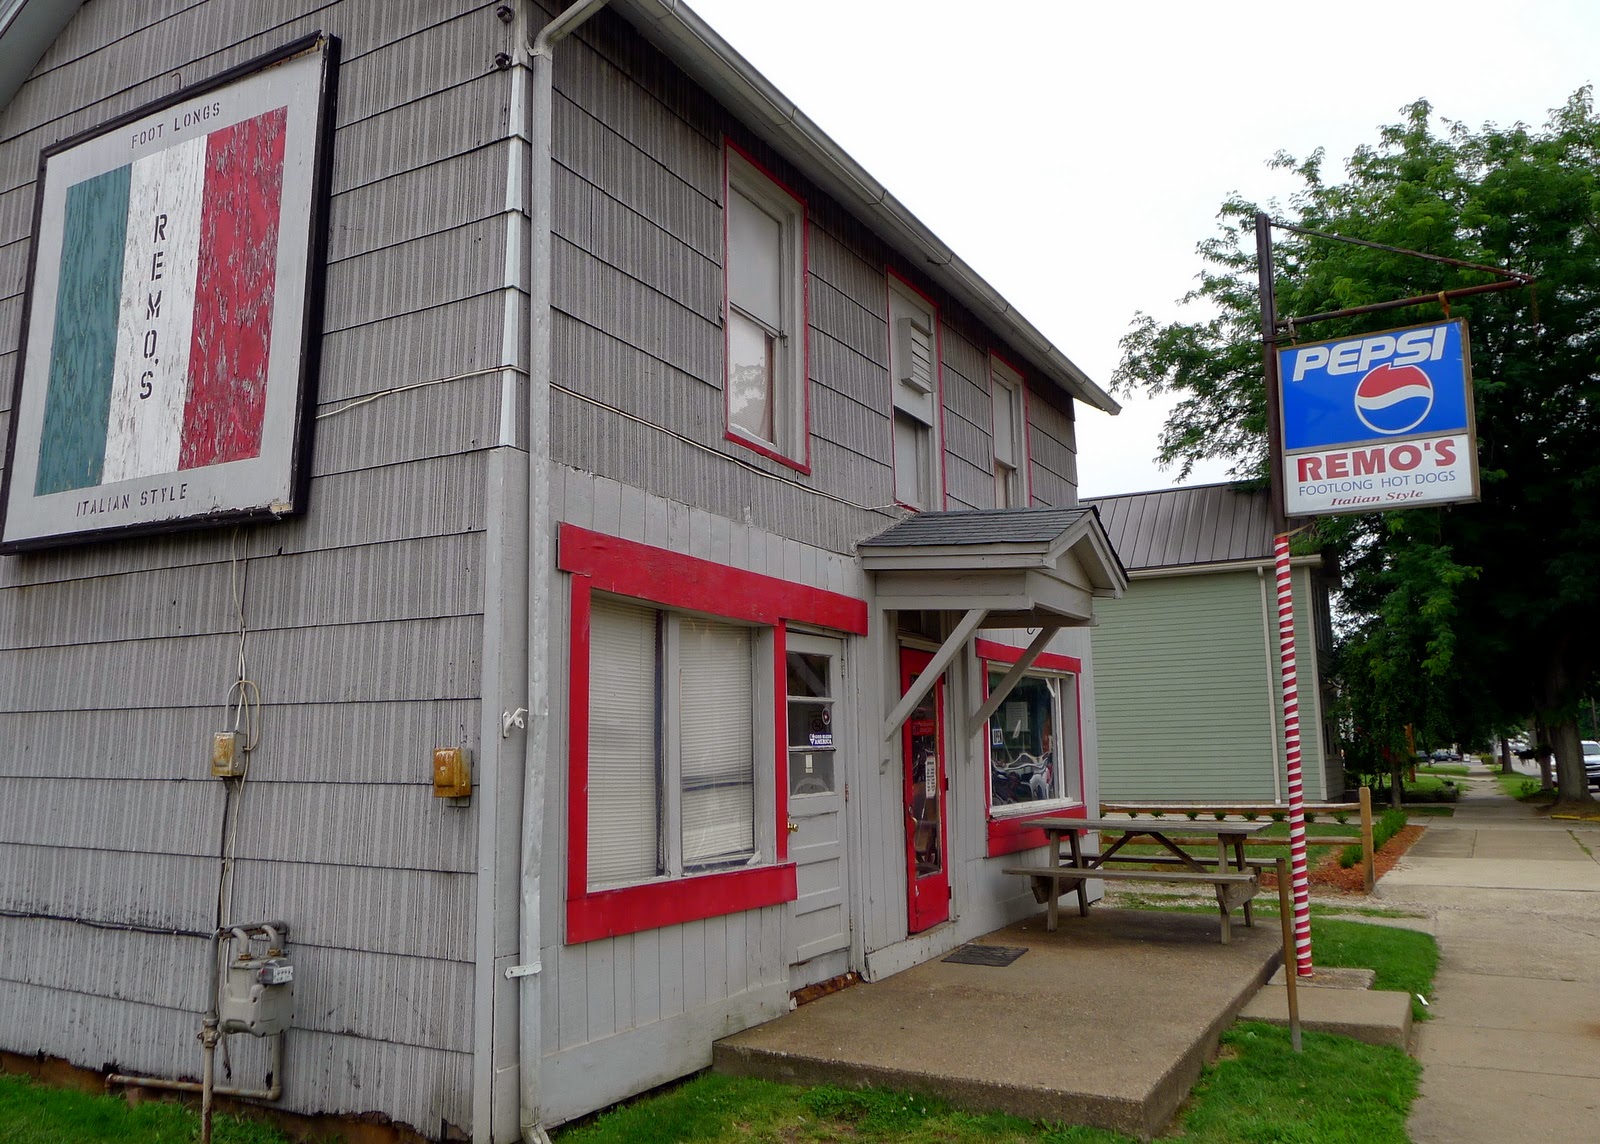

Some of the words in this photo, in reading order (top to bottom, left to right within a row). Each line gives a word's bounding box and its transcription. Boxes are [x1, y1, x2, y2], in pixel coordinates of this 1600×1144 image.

[131, 123, 164, 149] FOOT
[174, 102, 220, 132] LONGS
[139, 213, 168, 401] REMO'S
[1292, 326, 1448, 382] PEPSI
[1297, 439, 1457, 483] REMO'S
[76, 494, 130, 517] ITALIAN
[140, 483, 188, 506] STYLE
[1299, 479, 1373, 496] FOOTLONG
[1381, 475, 1409, 488] HOT
[1415, 471, 1456, 485] DOGS
[1330, 495, 1381, 507] Italian
[1385, 489, 1424, 501] Style
